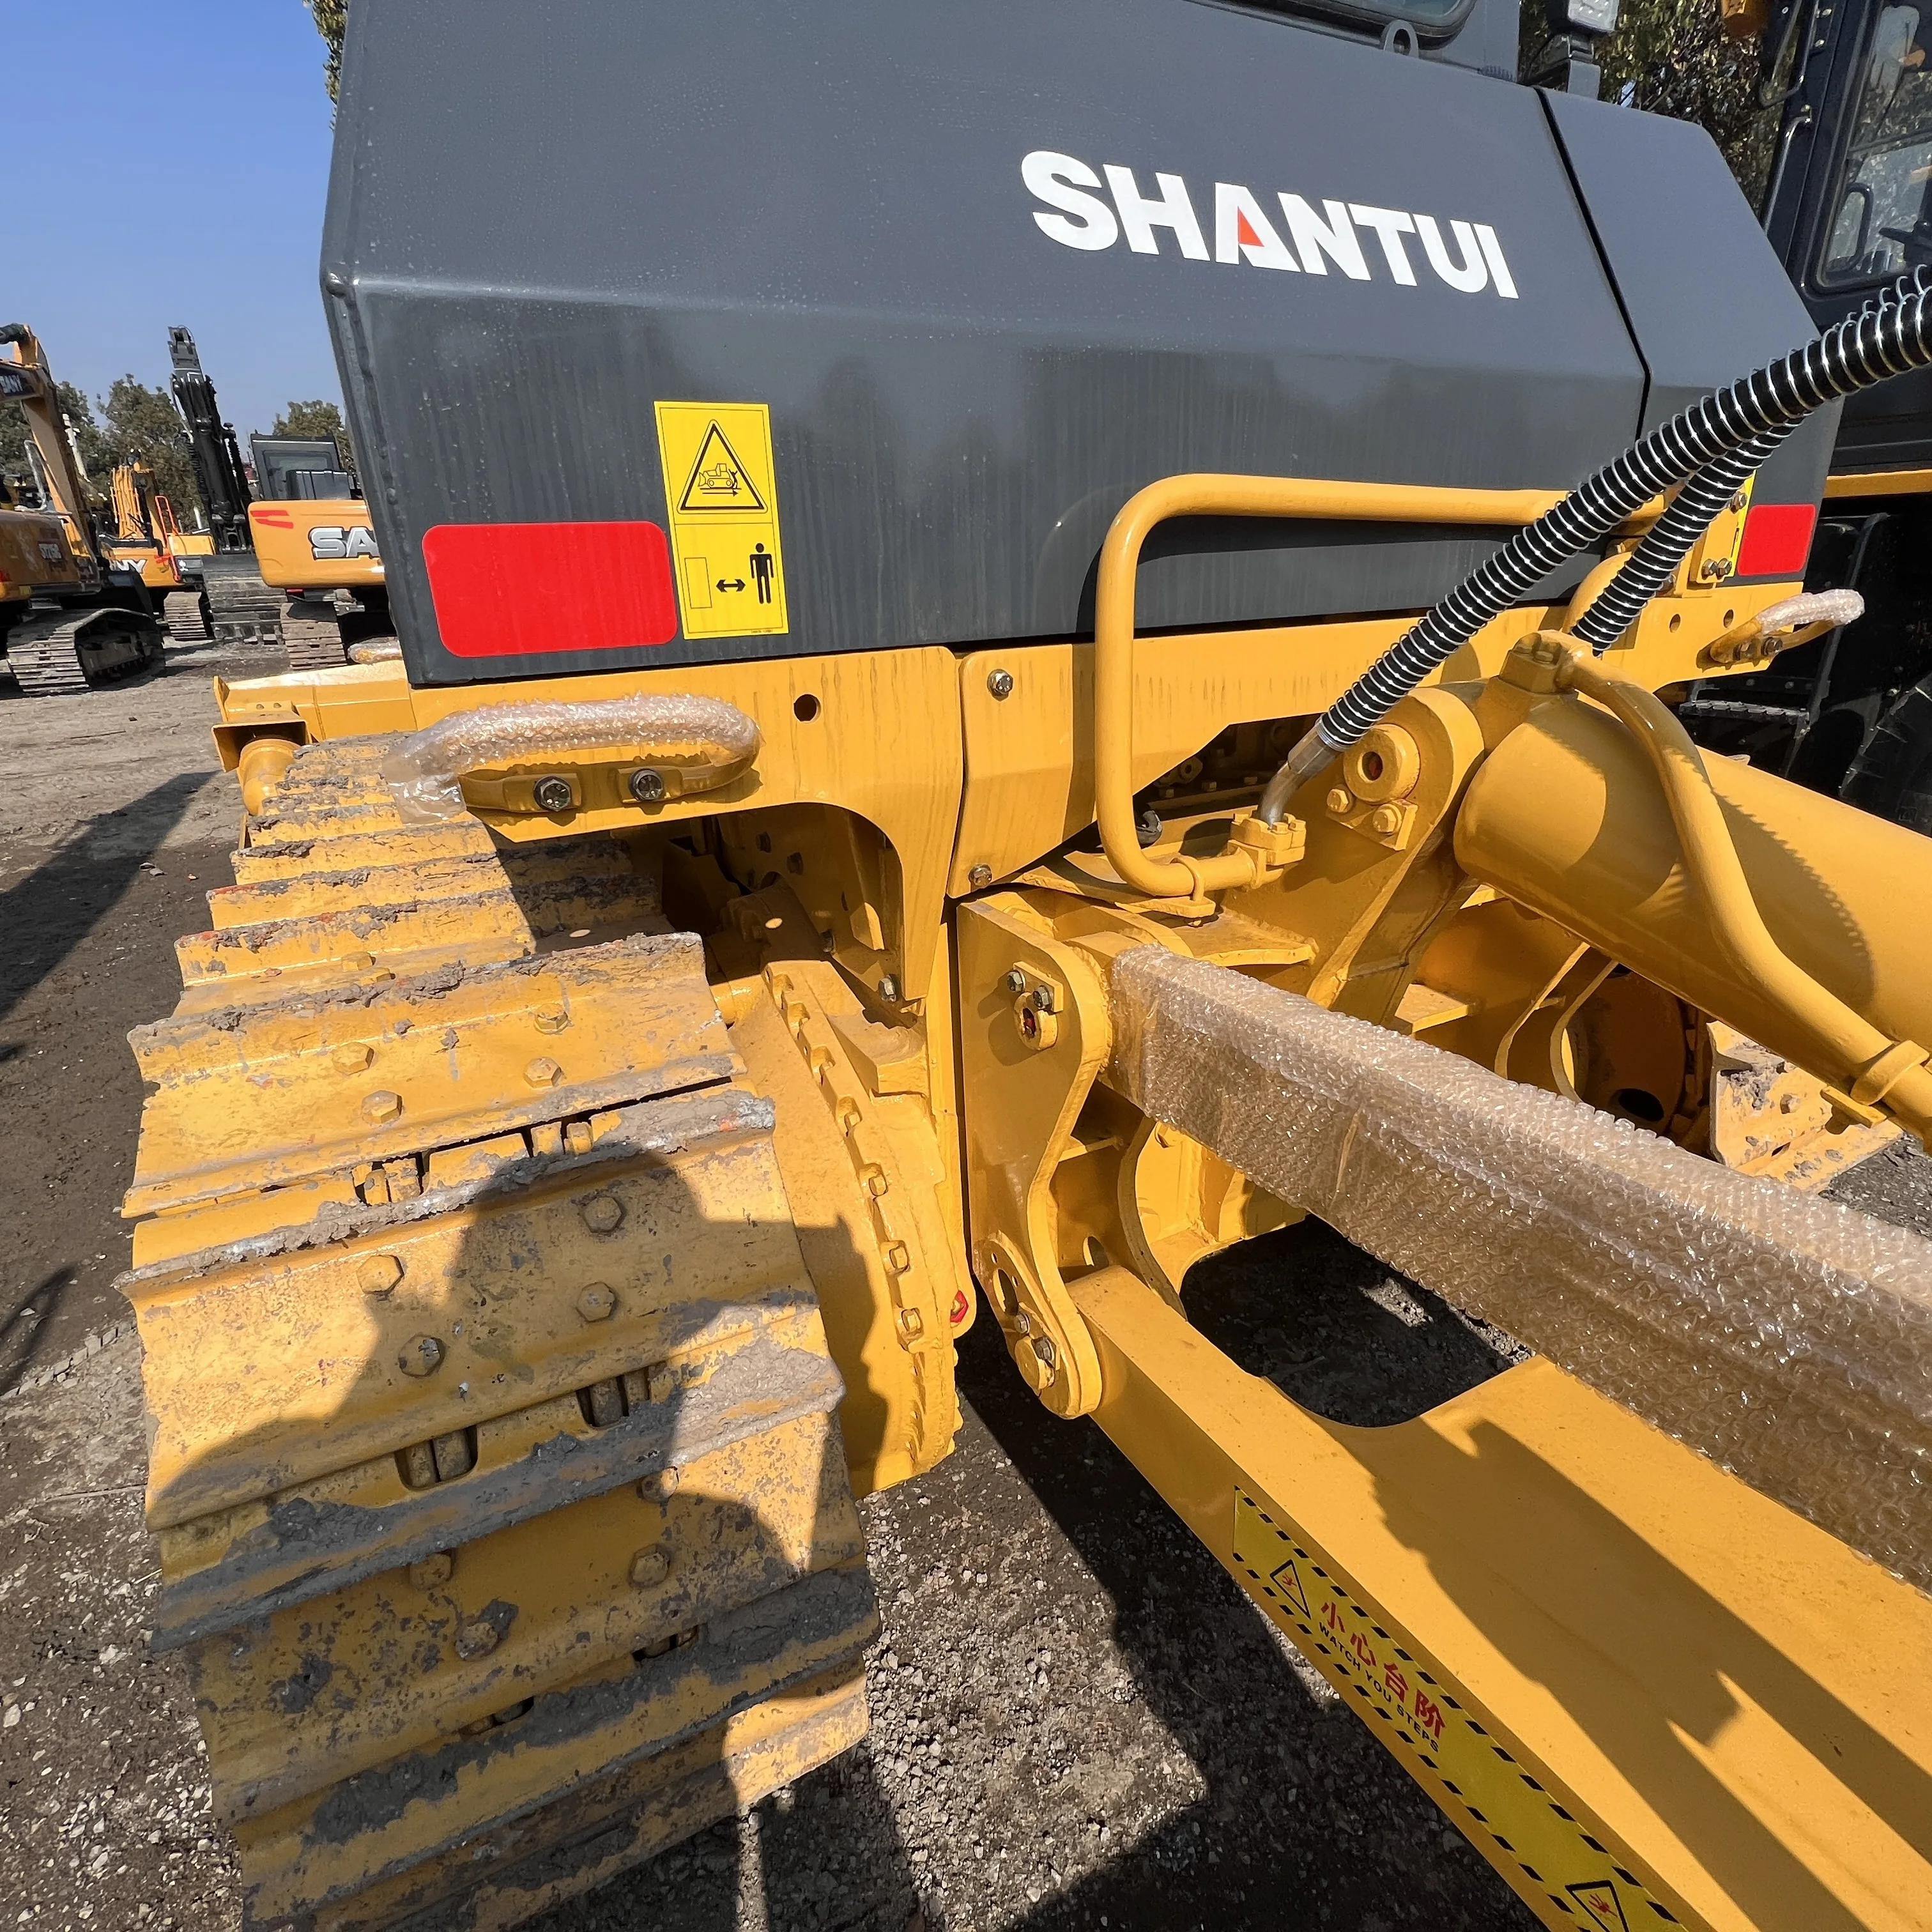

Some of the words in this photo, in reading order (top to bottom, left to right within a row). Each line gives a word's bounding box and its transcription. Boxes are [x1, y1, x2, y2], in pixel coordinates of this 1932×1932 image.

[1021, 151, 1519, 299] SHANTUI
[1319, 1621, 1361, 1671] WATCH
[1365, 1669, 1392, 1703] YOU
[1396, 1704, 1439, 1753] STEPS
[1320, 1602, 1446, 1739] 小心台阶
